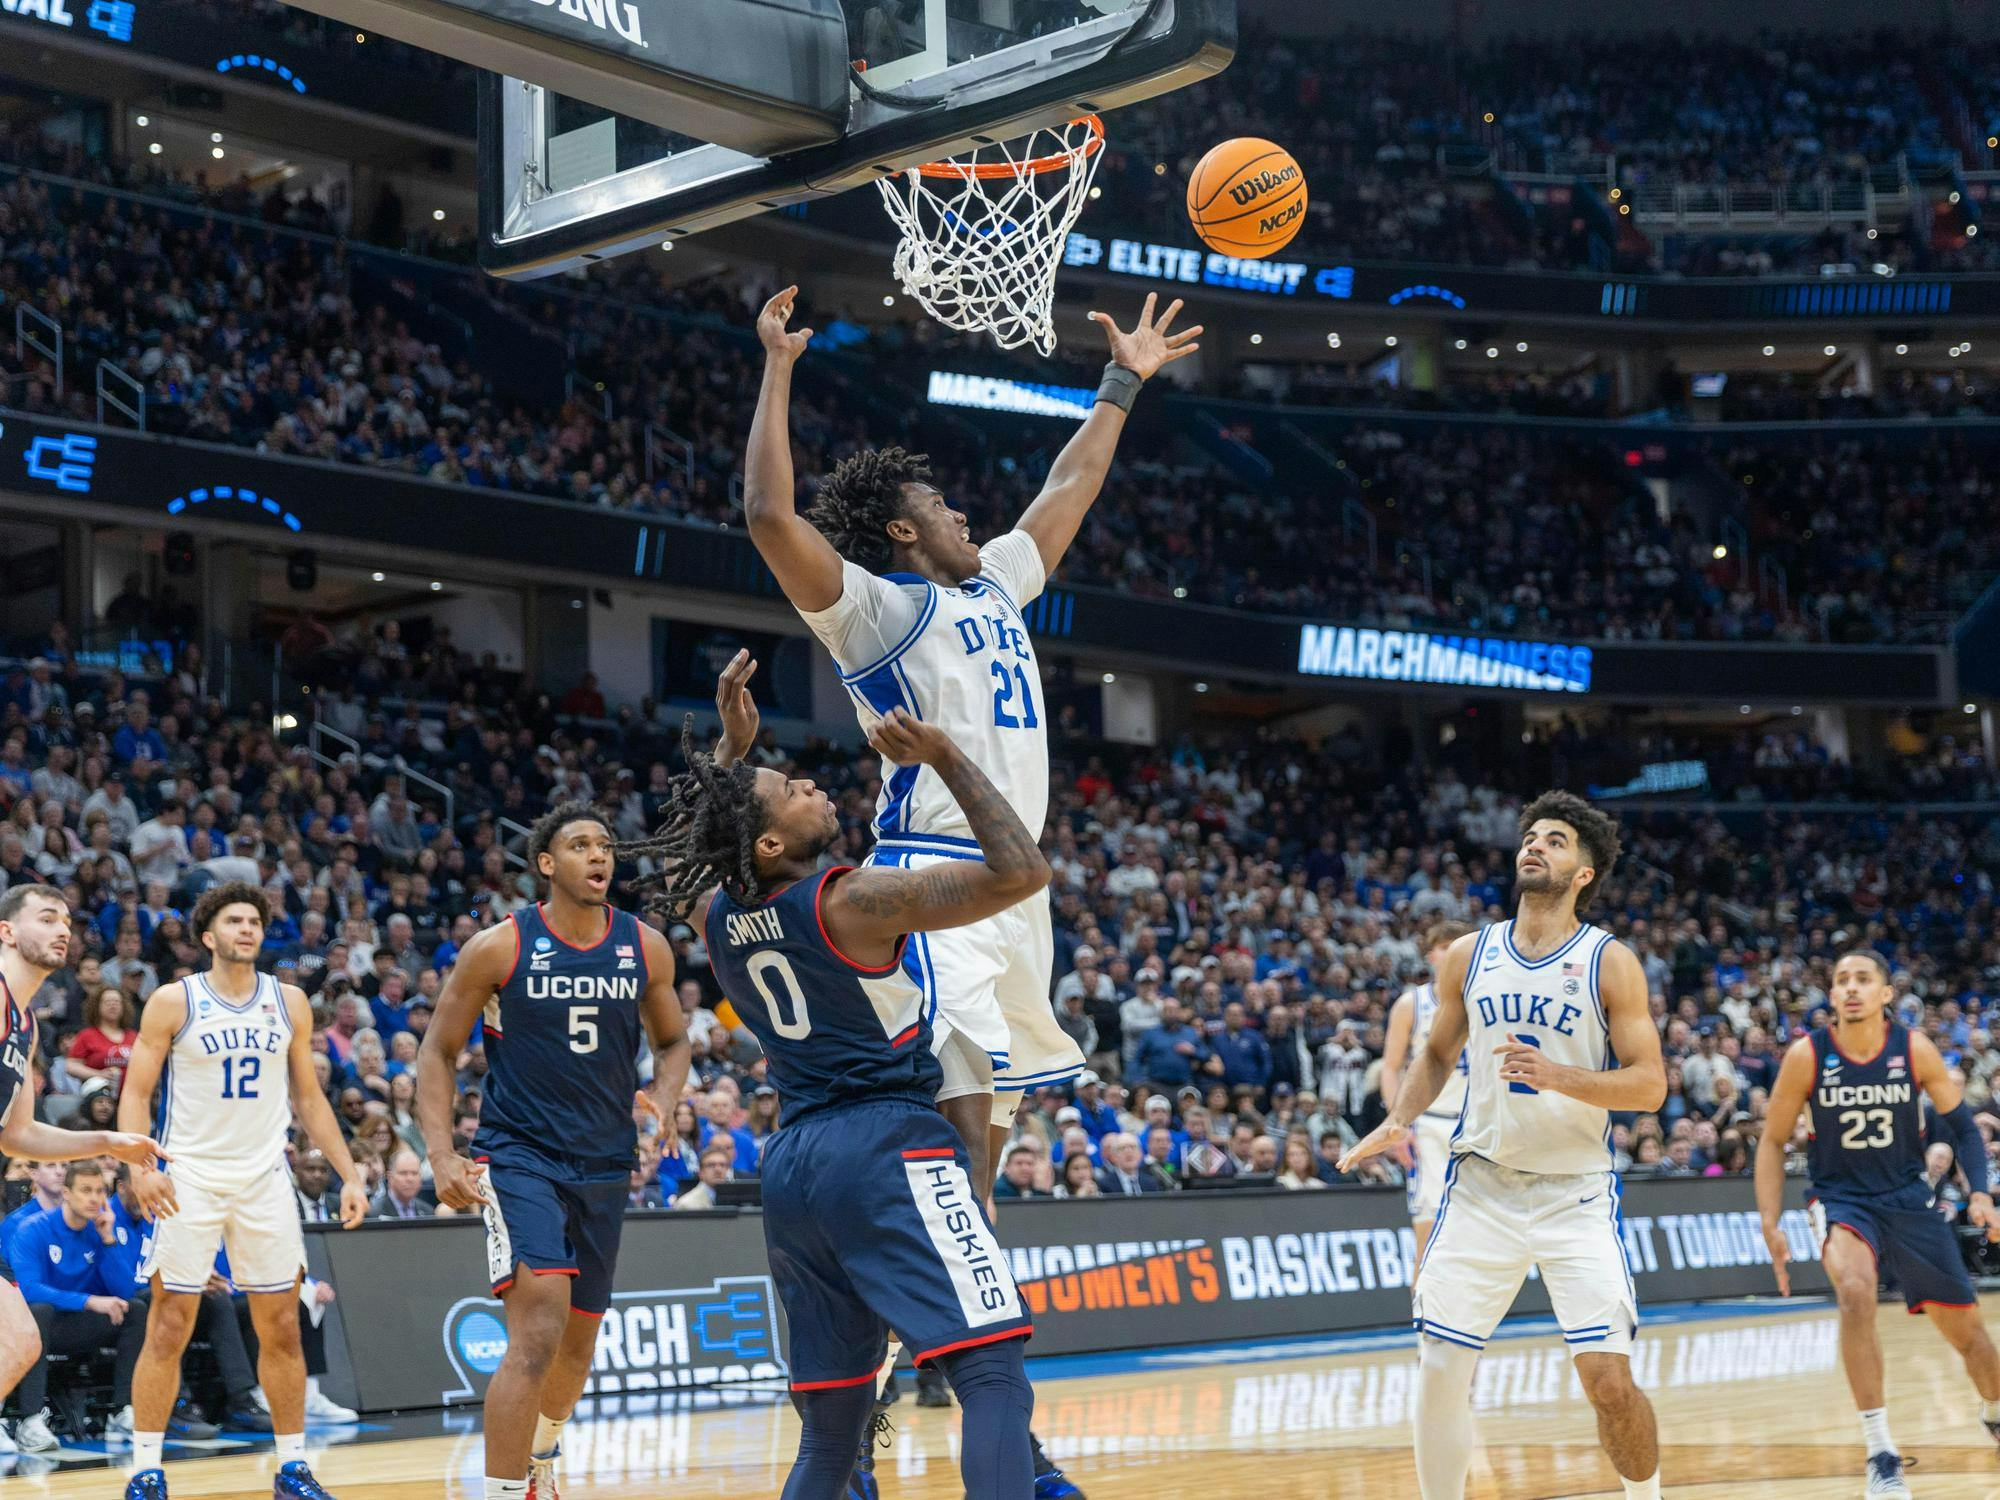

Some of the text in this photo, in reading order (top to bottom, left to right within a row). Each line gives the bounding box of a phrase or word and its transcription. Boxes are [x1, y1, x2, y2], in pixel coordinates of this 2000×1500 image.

[1229, 165, 1299, 206] Wilson
[1259, 198, 1303, 234] NCAA
[1108, 238, 1202, 283] ELITE
[954, 614, 1031, 661] DKE
[991, 658, 1038, 729] 21
[726, 906, 785, 946] SMITH
[526, 975, 638, 1000] UCONN
[745, 949, 812, 1041] 0
[568, 1005, 600, 1054] 5
[1476, 992, 1583, 1037] DUKE
[200, 1027, 282, 1055] DUKE
[221, 1056, 261, 1099] 12
[1818, 1083, 1911, 1108] UCONN
[1838, 1108, 1895, 1150] 23
[926, 1165, 1007, 1311] HUSKIES
[1002, 1239, 1220, 1315] WOMEN'S
[589, 1303, 690, 1372] RCH
